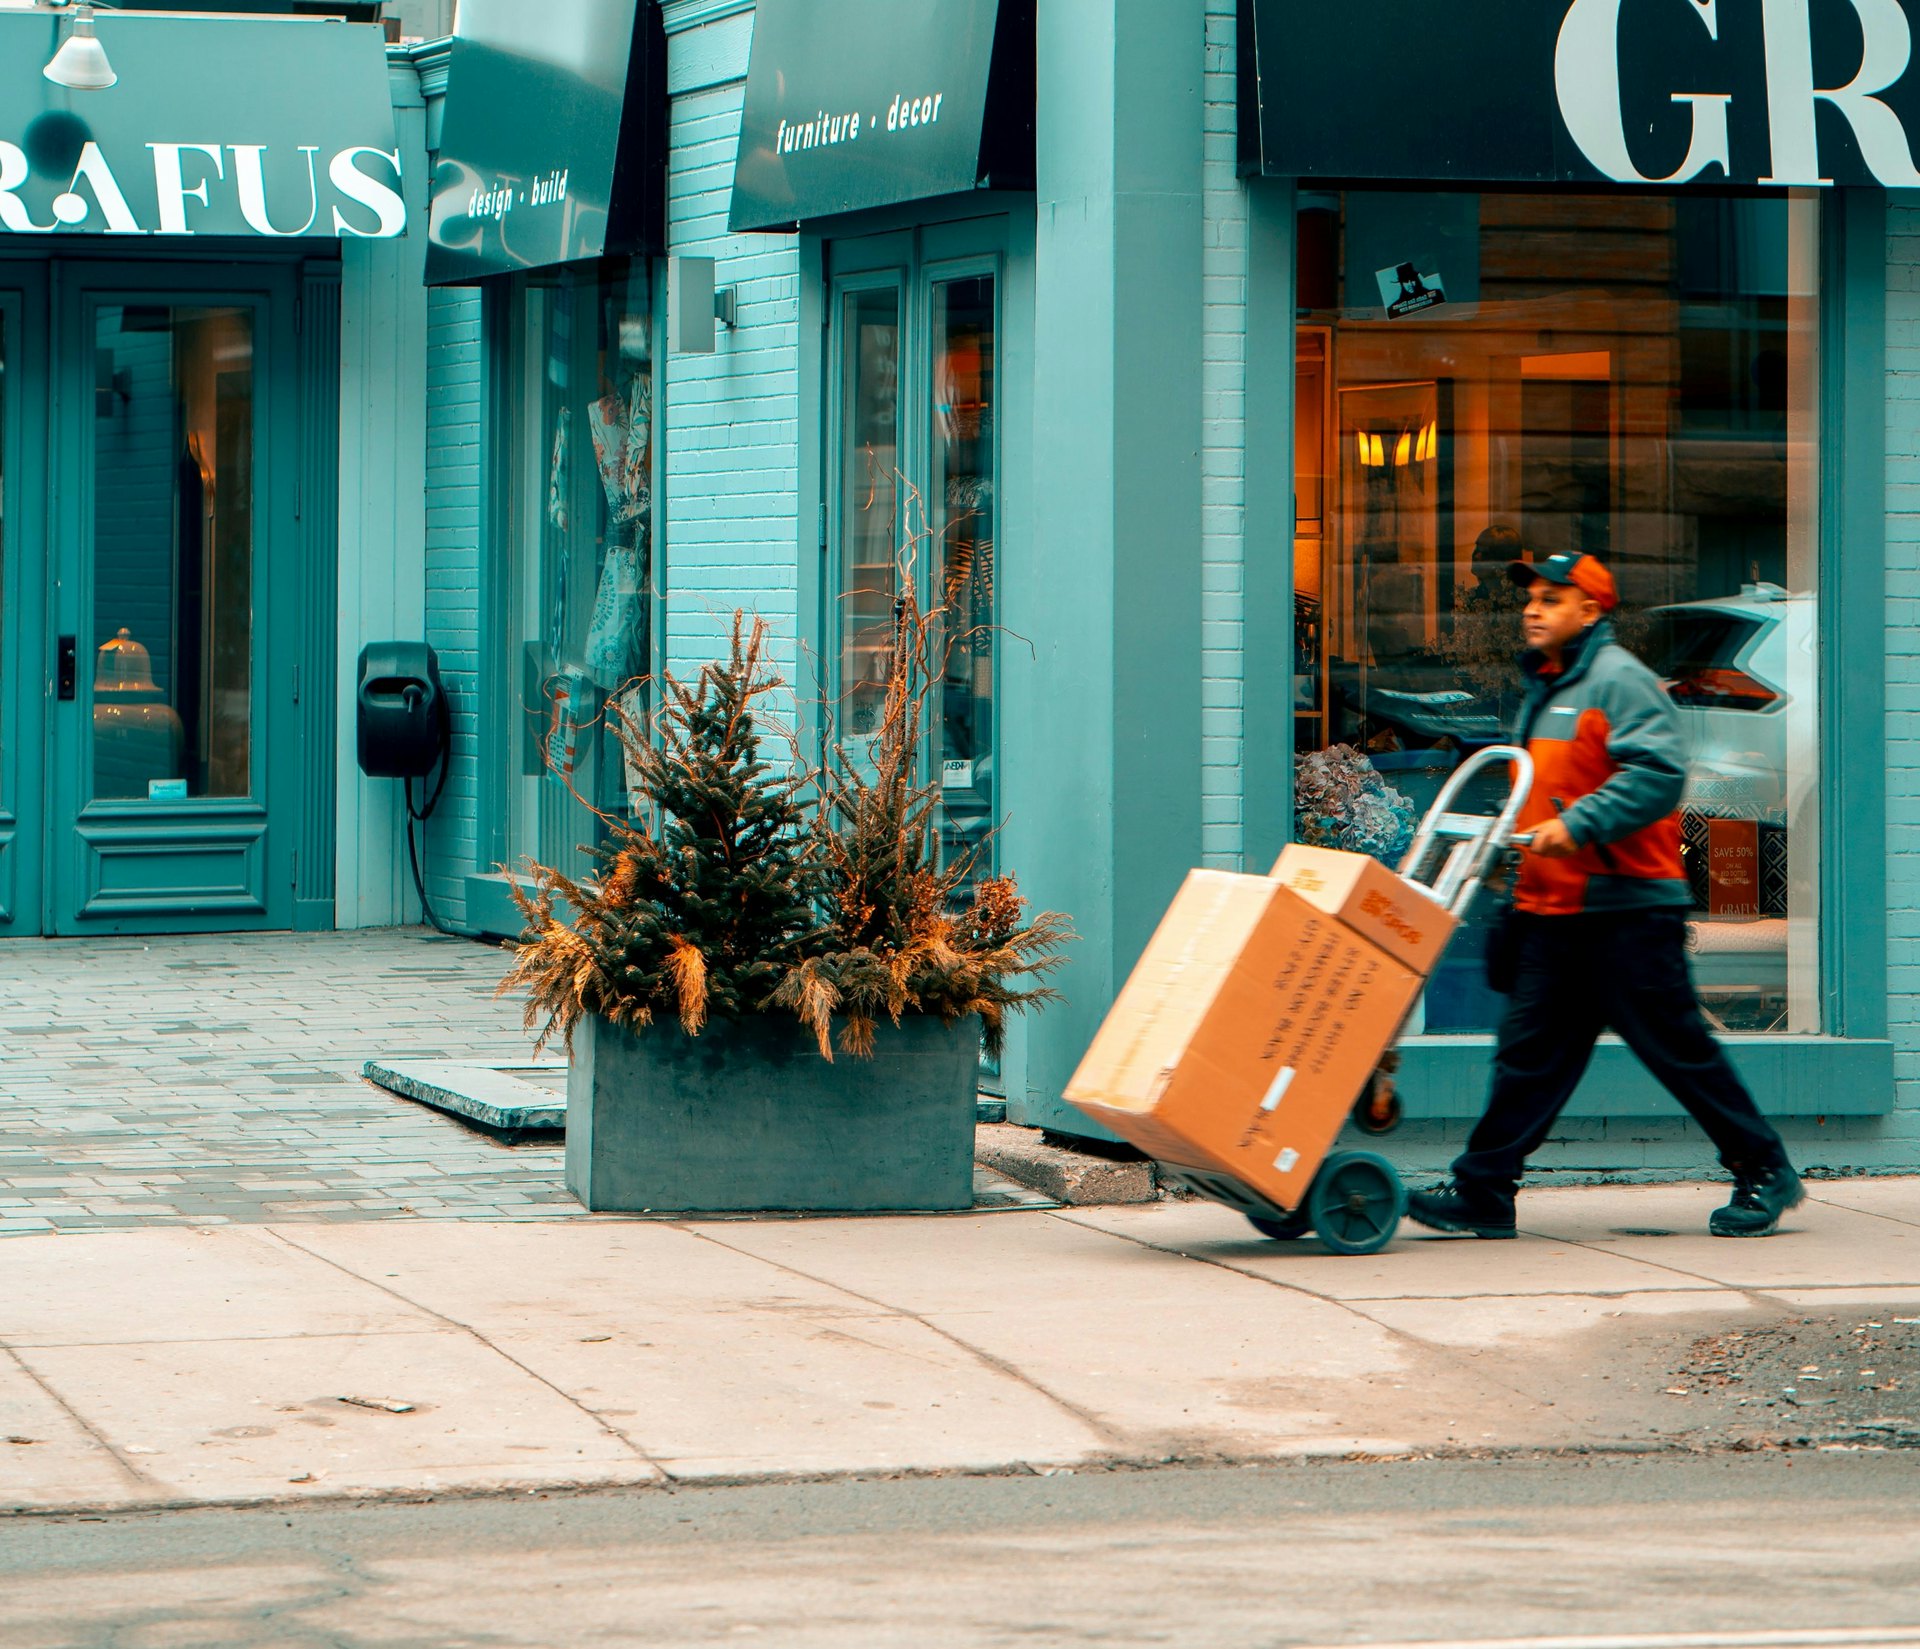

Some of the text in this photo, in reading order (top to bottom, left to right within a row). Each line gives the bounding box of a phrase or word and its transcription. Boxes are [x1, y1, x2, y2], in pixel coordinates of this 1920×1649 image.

[1554, 0, 1920, 188] GR
[776, 93, 943, 155] furniture decor
[468, 168, 568, 221] design build
[1714, 846, 1754, 858] SAVE 50%
